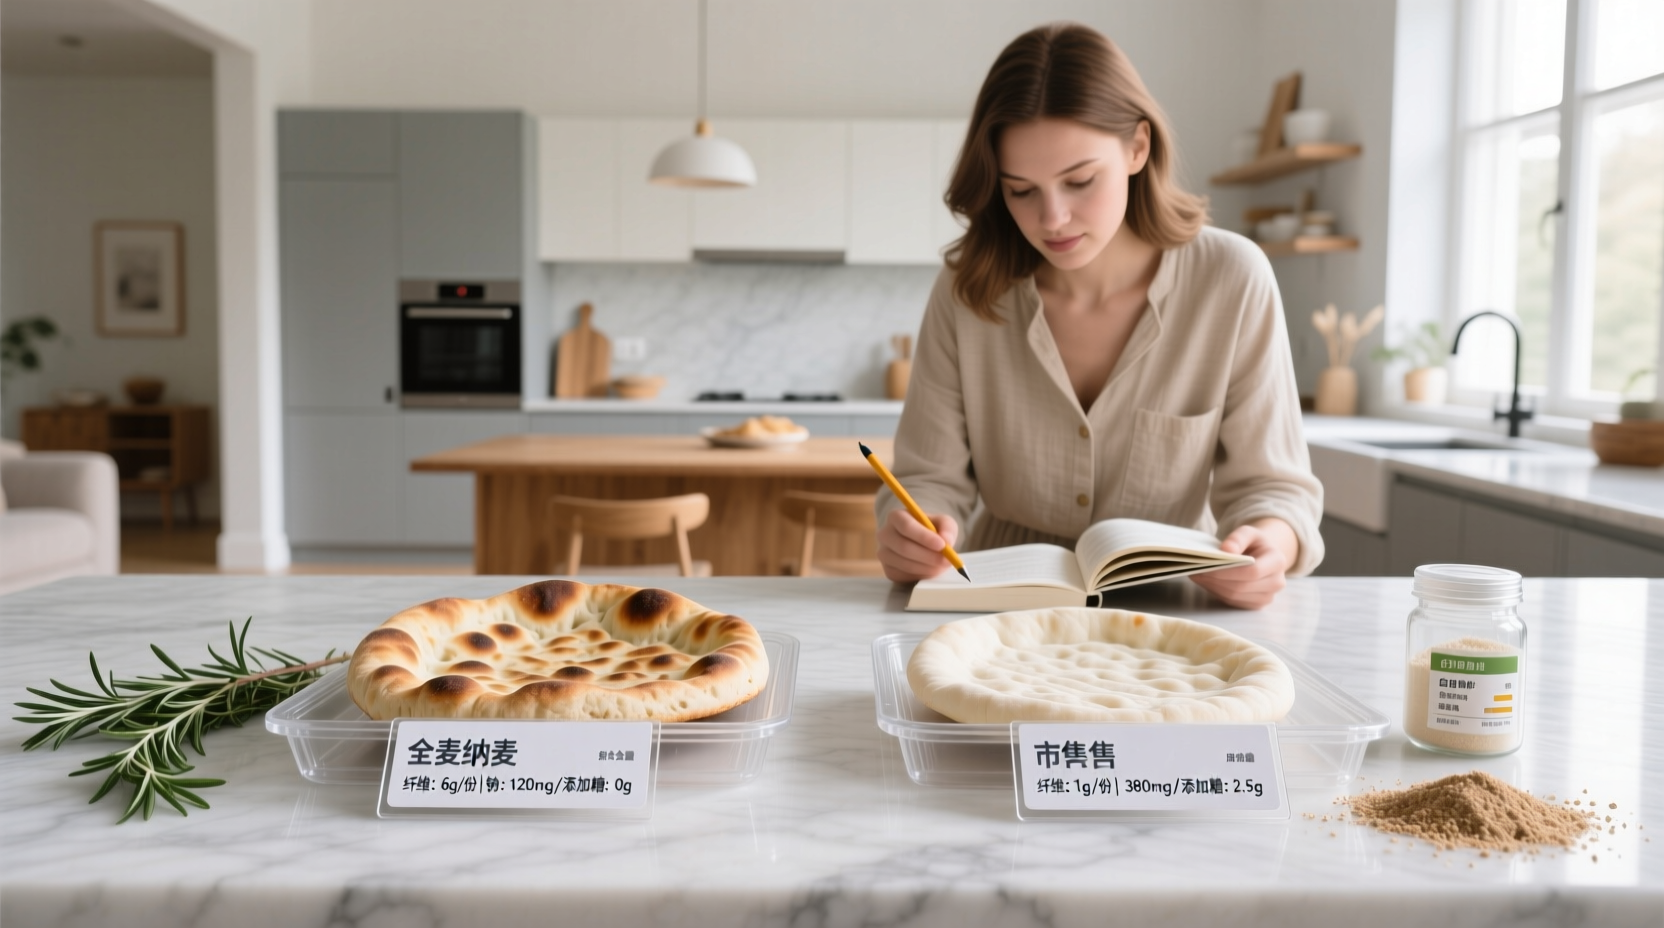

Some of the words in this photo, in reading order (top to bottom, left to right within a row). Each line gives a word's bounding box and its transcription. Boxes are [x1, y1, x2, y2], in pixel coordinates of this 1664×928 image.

[408, 738, 518, 768] 全麦纳麦
[615, 778, 632, 796] 0g
[1233, 779, 1264, 798] 2.5g
